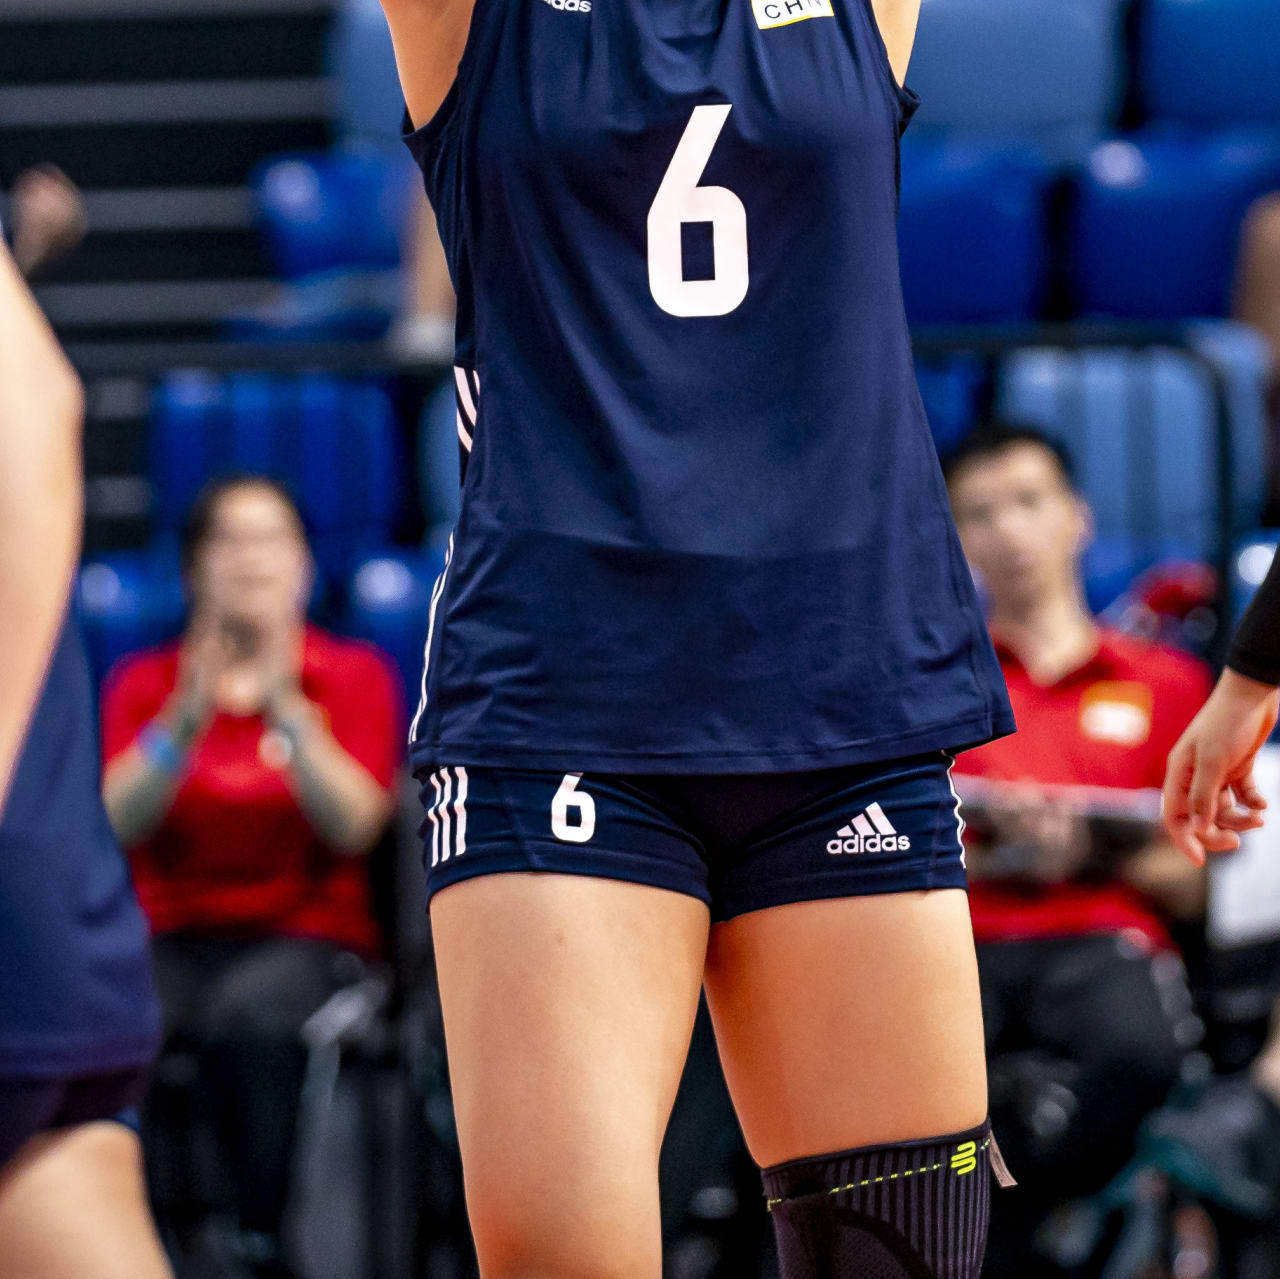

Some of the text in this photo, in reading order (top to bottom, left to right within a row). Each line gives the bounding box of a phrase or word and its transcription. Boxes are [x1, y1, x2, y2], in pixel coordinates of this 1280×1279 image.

[647, 104, 749, 317] 6
[551, 771, 596, 843] 6
[826, 833, 911, 855] adidas
